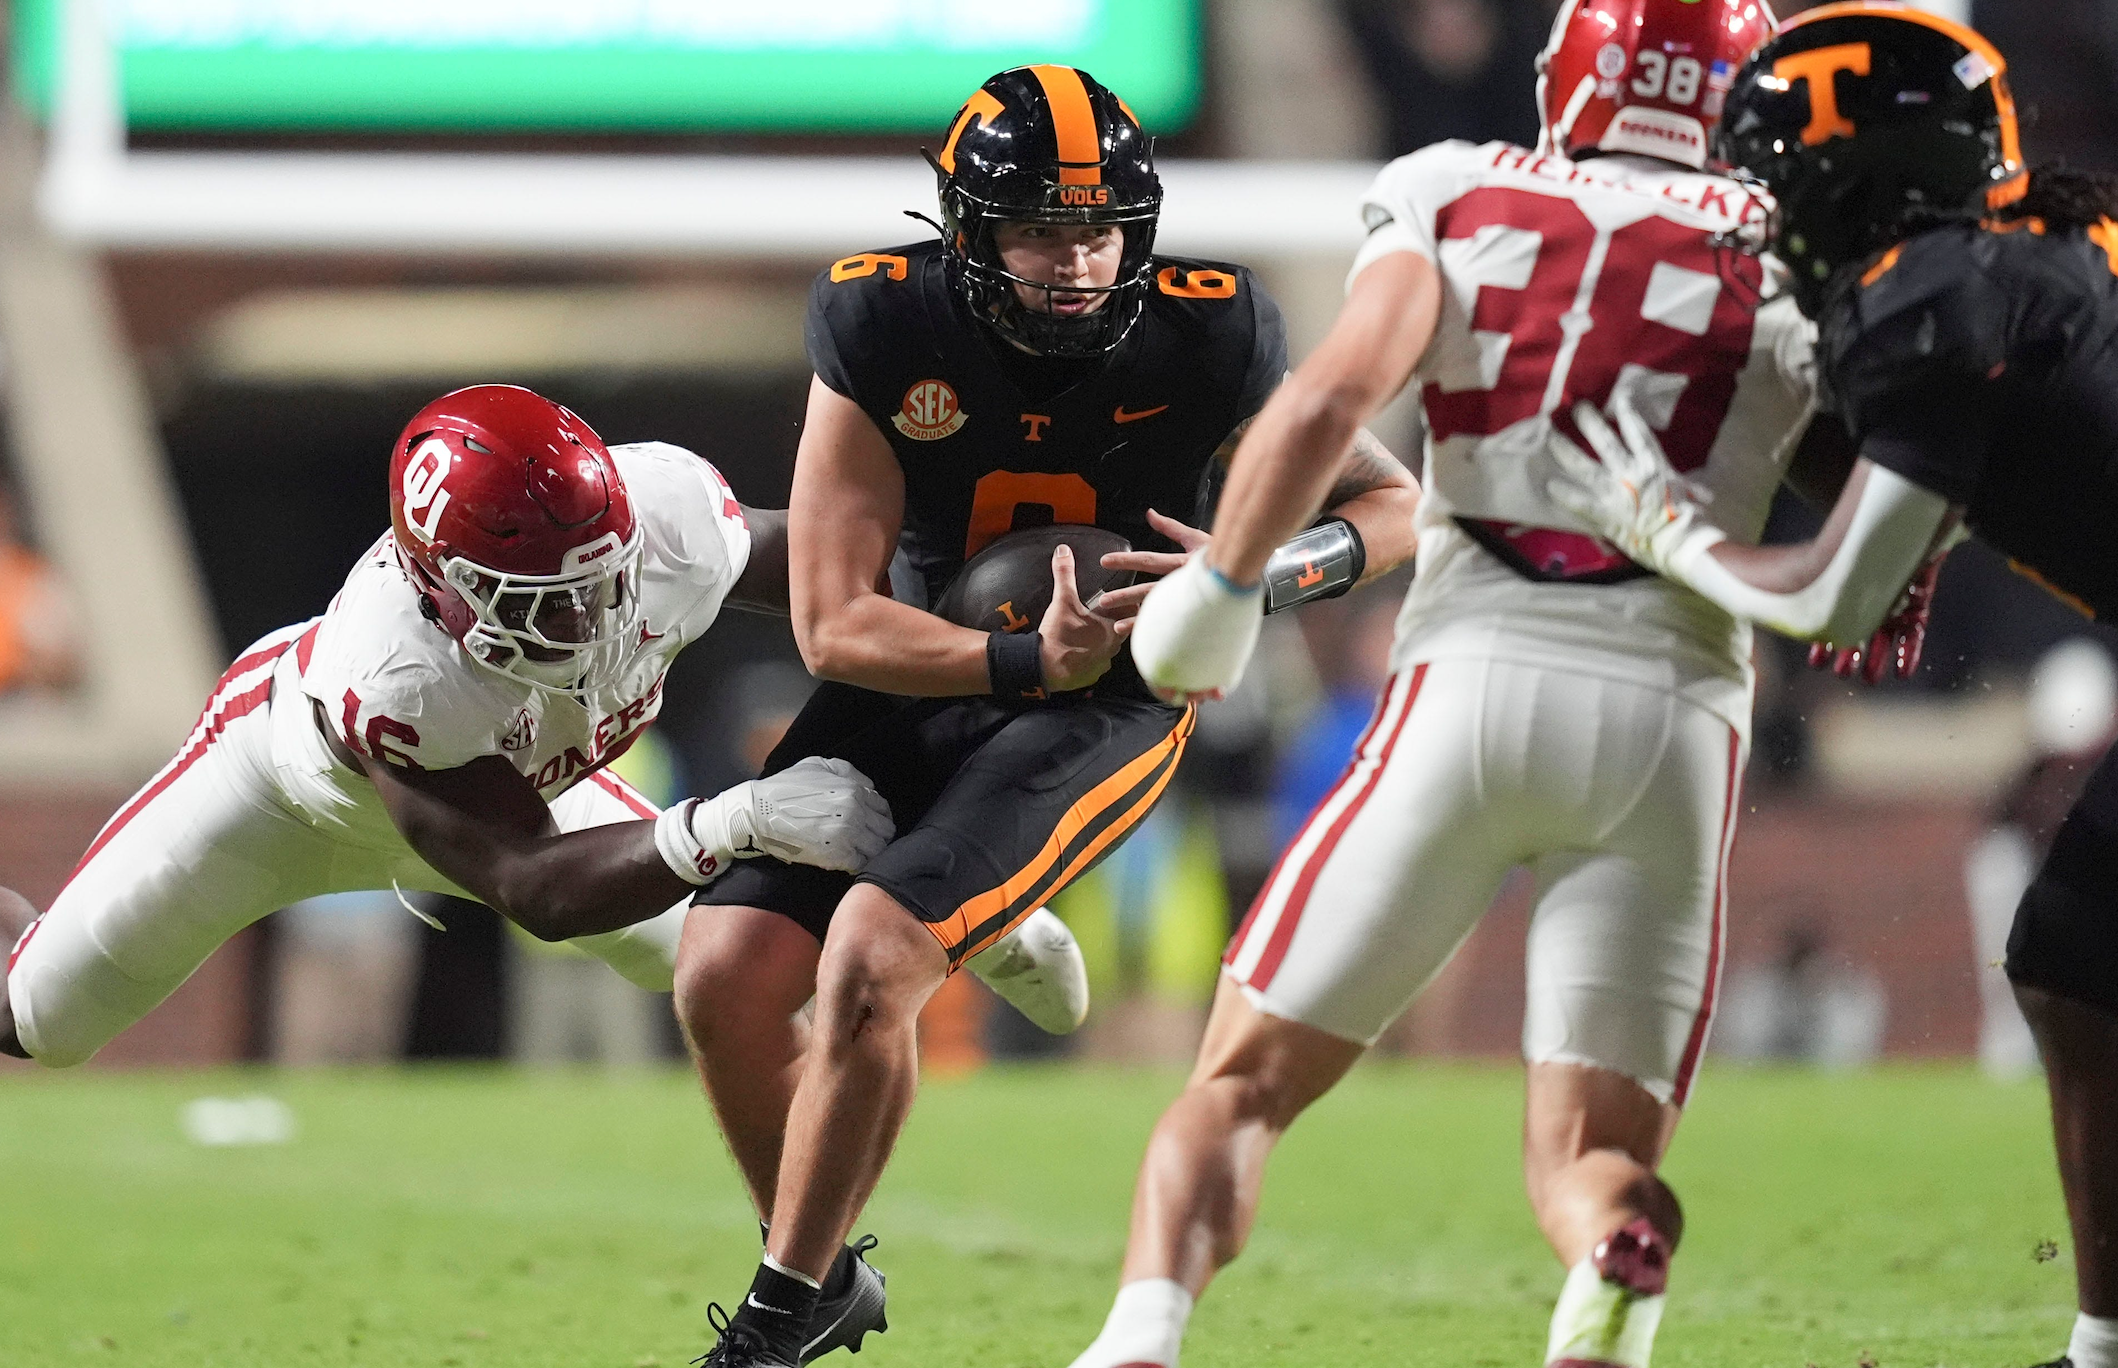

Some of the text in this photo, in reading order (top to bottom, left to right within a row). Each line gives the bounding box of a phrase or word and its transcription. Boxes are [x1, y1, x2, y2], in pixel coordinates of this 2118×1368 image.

[1631, 50, 1701, 105] 38
[1774, 41, 1872, 146] T
[1060, 189, 1108, 205] VOLS
[830, 253, 908, 284] 6
[1157, 267, 1237, 299] 6
[1422, 186, 1763, 473] 38
[909, 383, 952, 425] SEC
[901, 421, 958, 439] GRADUATE
[1020, 414, 1051, 441] T
[552, 597, 580, 609] THE
[995, 600, 1030, 634] T
[342, 687, 424, 771] 16
[526, 671, 664, 791] ONERS
